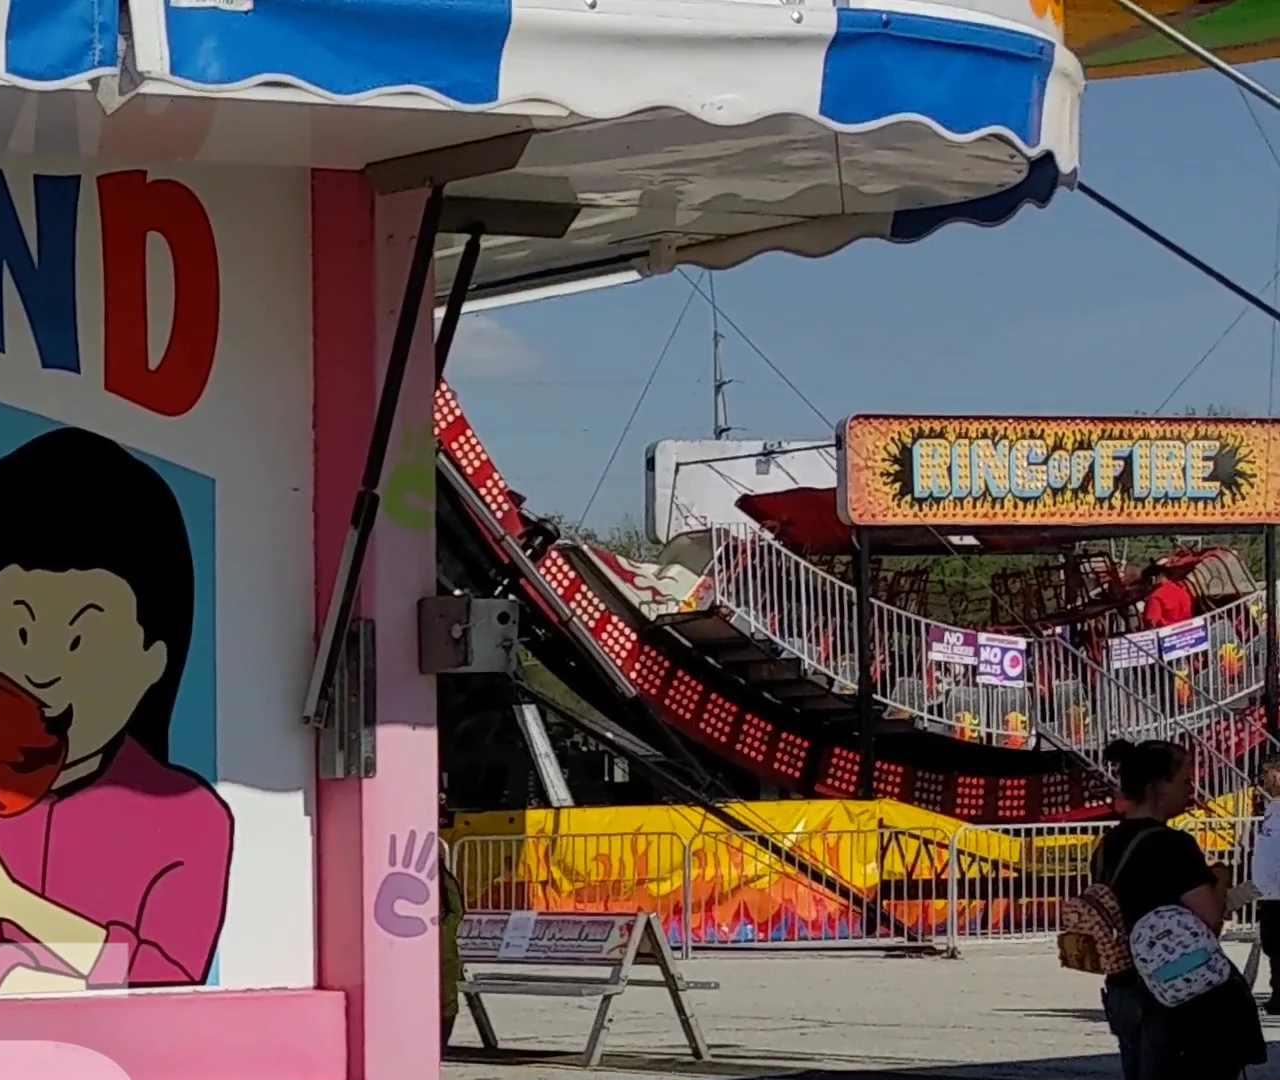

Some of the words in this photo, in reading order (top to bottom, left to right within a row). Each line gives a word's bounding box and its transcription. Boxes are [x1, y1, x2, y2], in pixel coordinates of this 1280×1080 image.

[912, 438, 1048, 499] RING
[1093, 439, 1222, 499] FIRE
[980, 646, 1002, 663] NO
